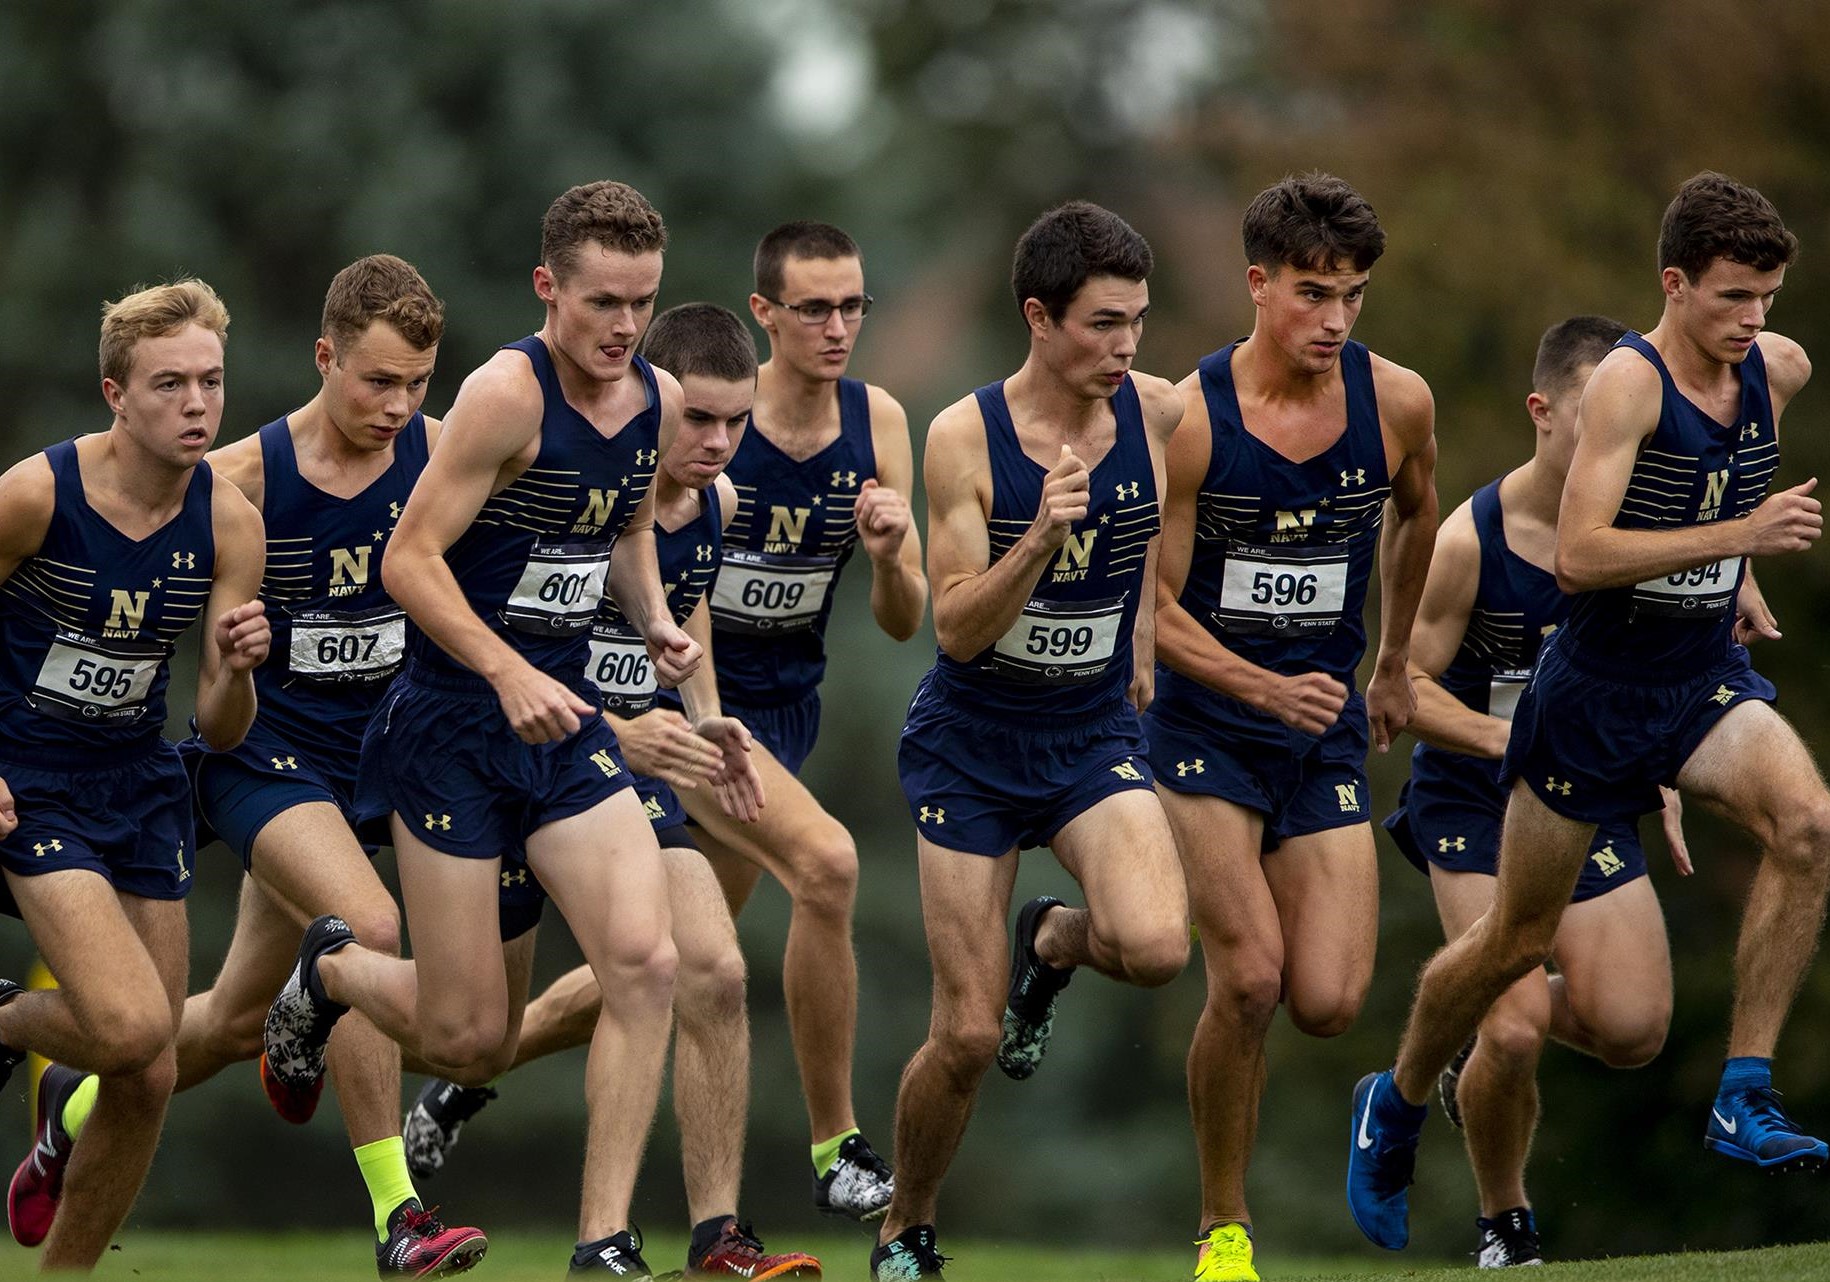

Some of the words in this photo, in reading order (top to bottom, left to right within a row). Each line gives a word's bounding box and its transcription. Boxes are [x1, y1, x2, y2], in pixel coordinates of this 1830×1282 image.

[1700, 469, 1729, 511] N
[576, 488, 619, 526] N
[1696, 507, 1720, 522] NAVY
[570, 524, 602, 536] NAVY
[766, 505, 811, 544] N
[540, 547, 551, 555] WE
[763, 542, 800, 554] NAVY
[1054, 529, 1098, 571] N
[1236, 546, 1250, 554] WE
[1270, 533, 1309, 543] NAVY
[329, 545, 372, 586] N
[733, 552, 746, 561] WE
[538, 572, 592, 606] 601
[1051, 569, 1089, 583] NAVY
[1251, 571, 1318, 606] 596
[328, 584, 366, 597] NAVY
[741, 578, 805, 610] 609
[105, 589, 149, 630] N
[67, 631, 81, 641] WE
[102, 627, 140, 640] NAVY
[592, 625, 605, 633] WE
[1026, 625, 1094, 657] 599
[317, 632, 380, 665] 607
[69, 658, 136, 699] 595
[596, 652, 650, 686] 606
[589, 749, 617, 774] N
[1334, 784, 1358, 805] N
[1590, 846, 1620, 873] N
